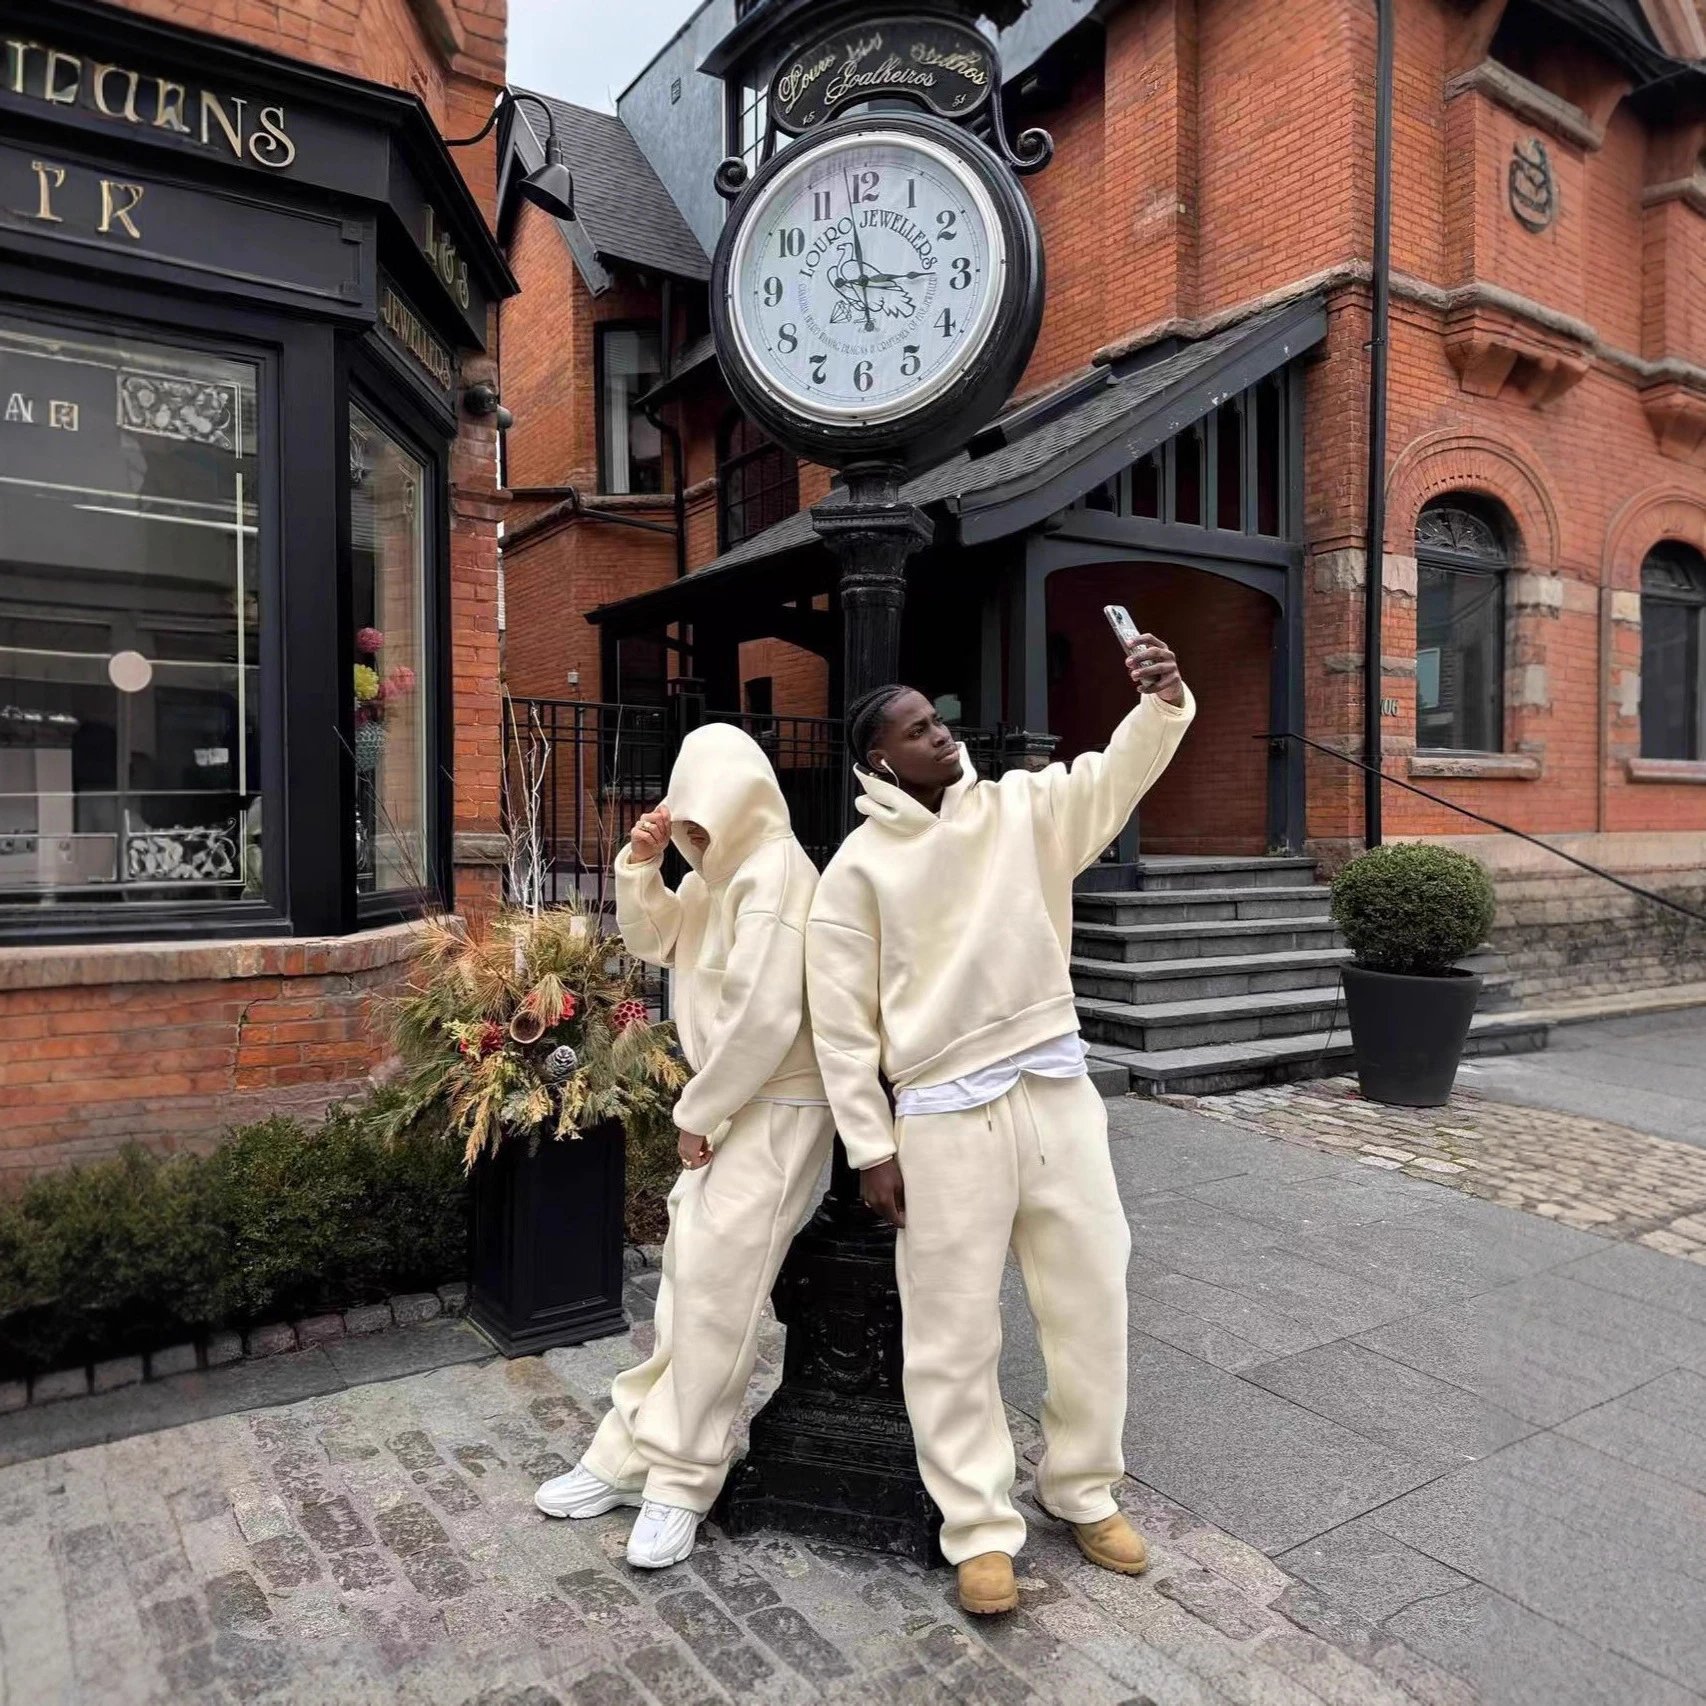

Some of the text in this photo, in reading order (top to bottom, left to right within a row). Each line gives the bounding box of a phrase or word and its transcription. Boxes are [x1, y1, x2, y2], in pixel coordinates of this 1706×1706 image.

[852, 171, 881, 205] 12
[906, 178, 917, 209] 1
[813, 191, 832, 222] 11
[936, 209, 957, 242] 2
[778, 227, 806, 258] 10
[799, 208, 939, 279] LOURO JEWELLERS
[949, 257, 972, 291] 3
[763, 276, 784, 308] 9
[777, 322, 799, 355] 8
[933, 307, 957, 339] 4
[809, 354, 828, 385] 7
[853, 360, 874, 393] 6
[900, 344, 921, 377] 5
